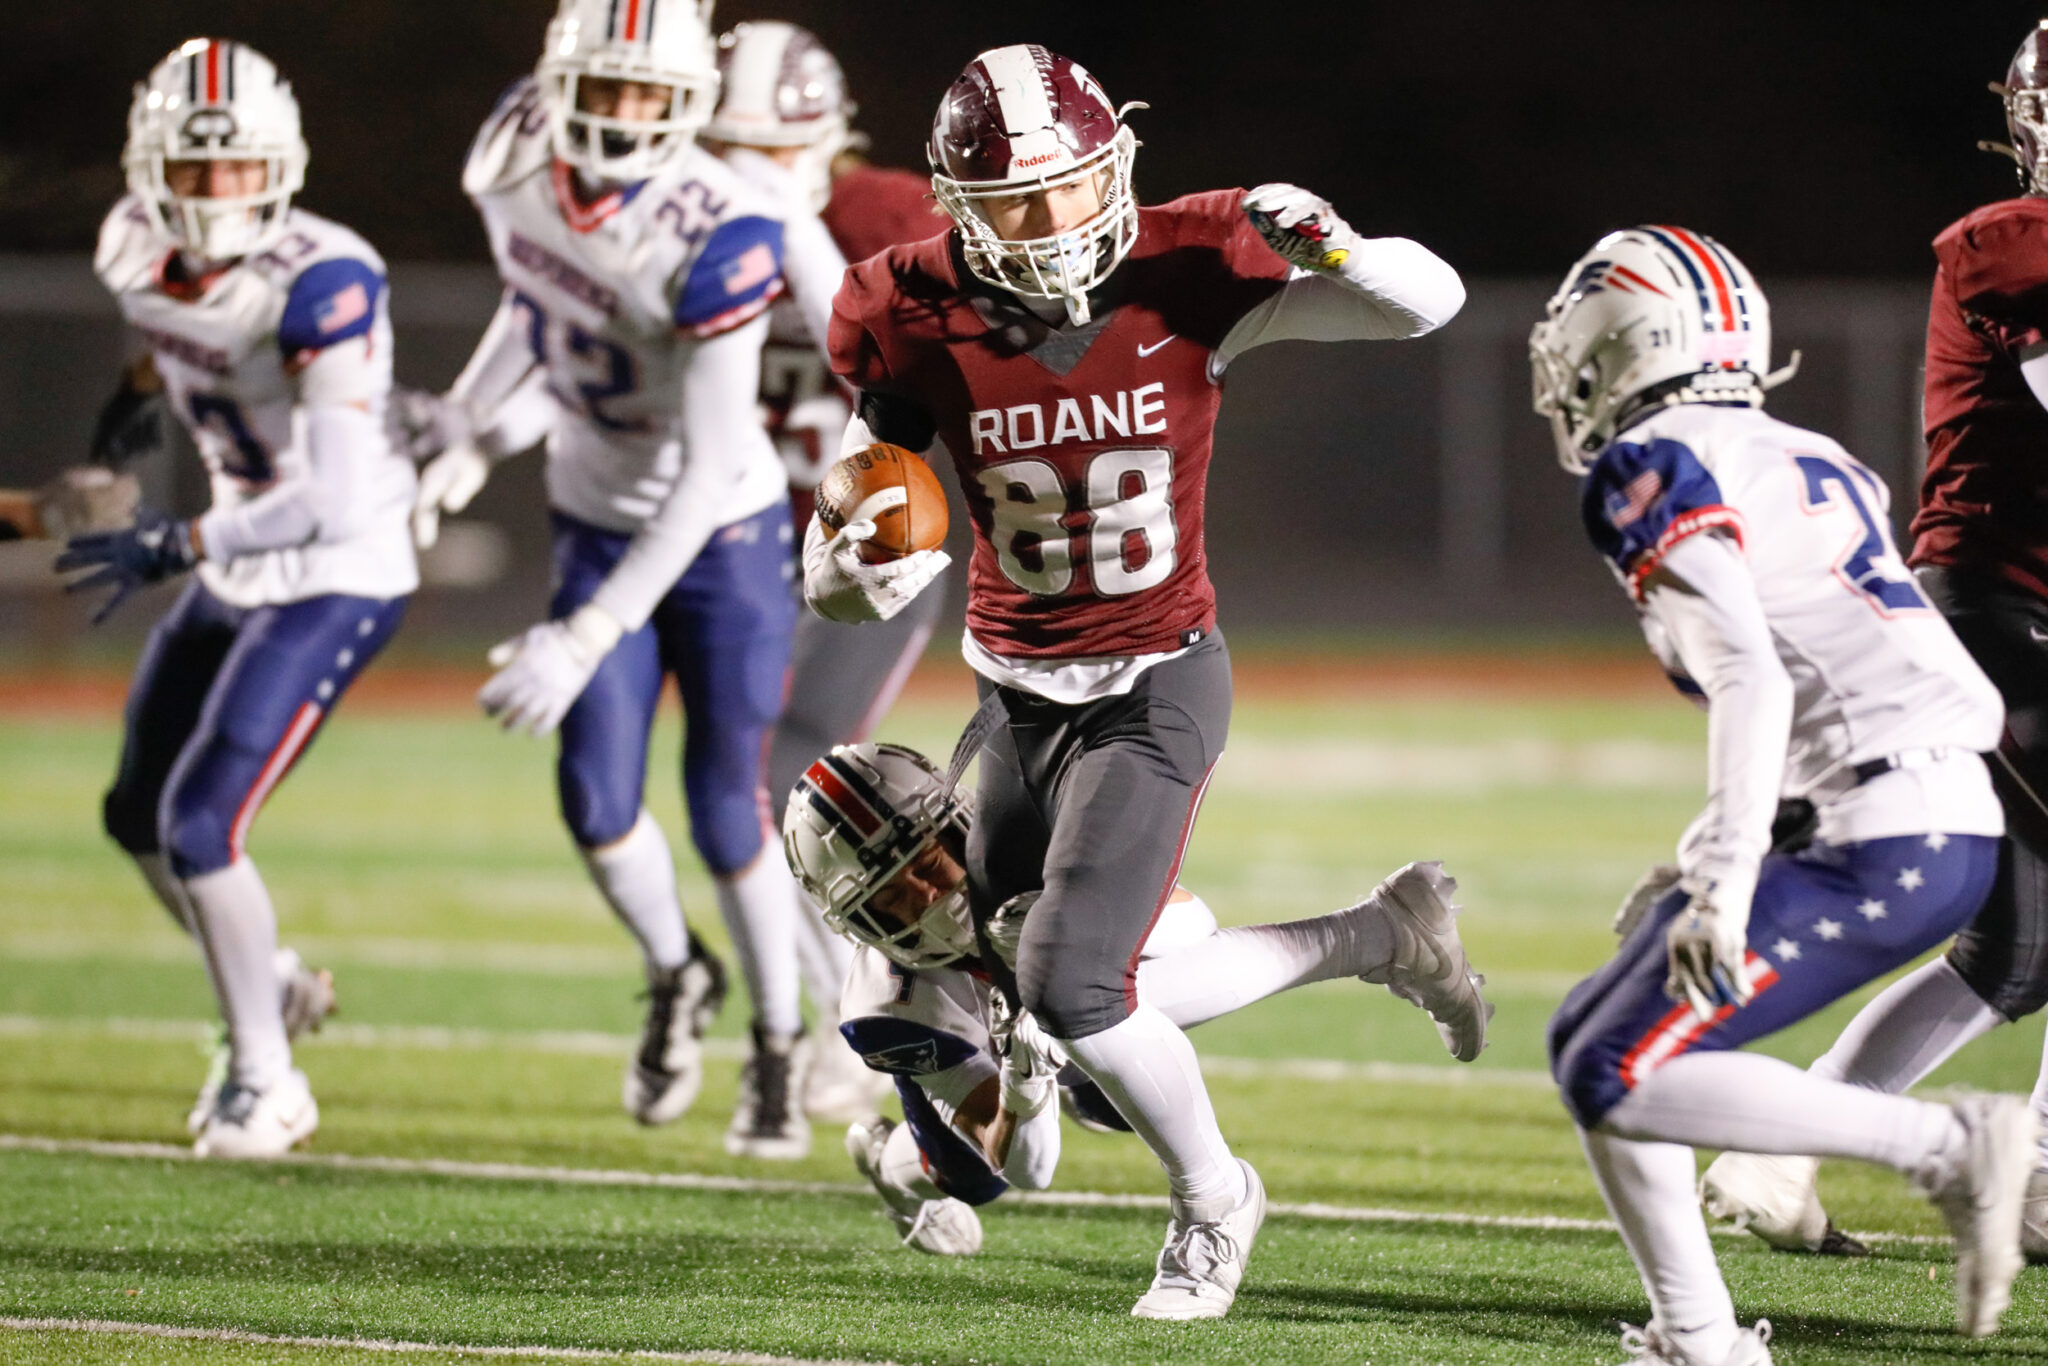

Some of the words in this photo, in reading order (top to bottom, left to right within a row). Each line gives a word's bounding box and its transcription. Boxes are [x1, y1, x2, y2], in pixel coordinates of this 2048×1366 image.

[655, 179, 728, 247] 22
[970, 381, 1168, 455] ROANE
[976, 446, 1179, 600] 88
